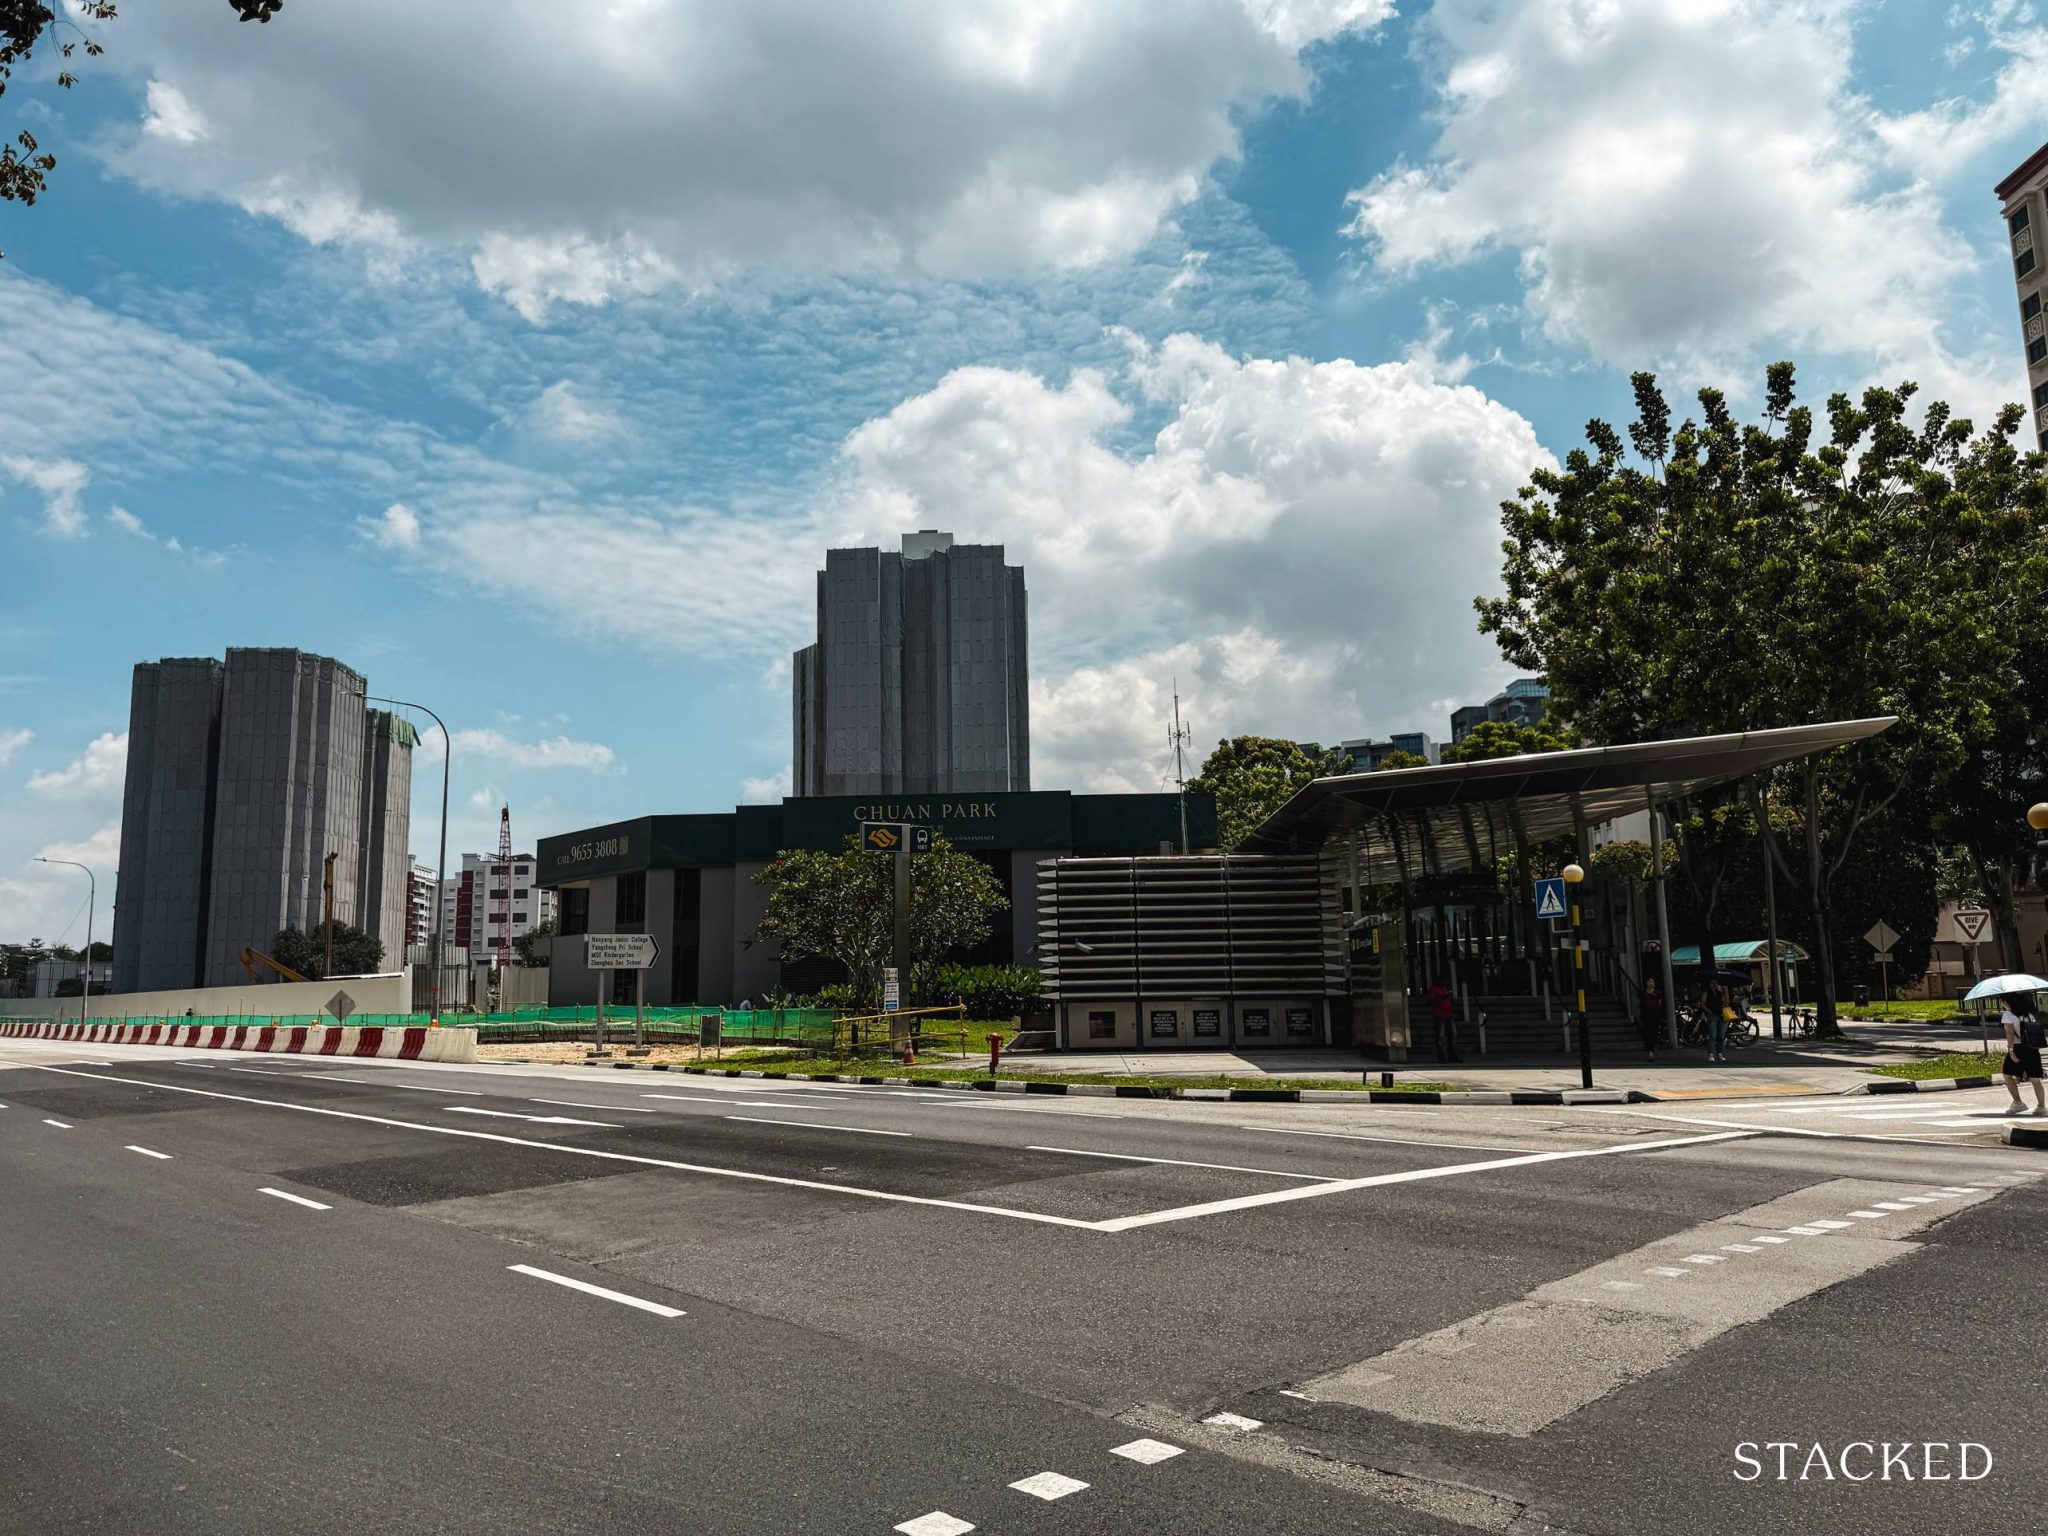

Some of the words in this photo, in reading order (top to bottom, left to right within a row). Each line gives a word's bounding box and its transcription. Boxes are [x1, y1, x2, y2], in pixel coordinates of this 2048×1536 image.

[854, 804, 930, 821] CHUAN
[942, 803, 998, 818] PARK
[557, 855, 570, 865] CALL
[571, 843, 593, 863] 9655
[594, 838, 617, 858] 3808
